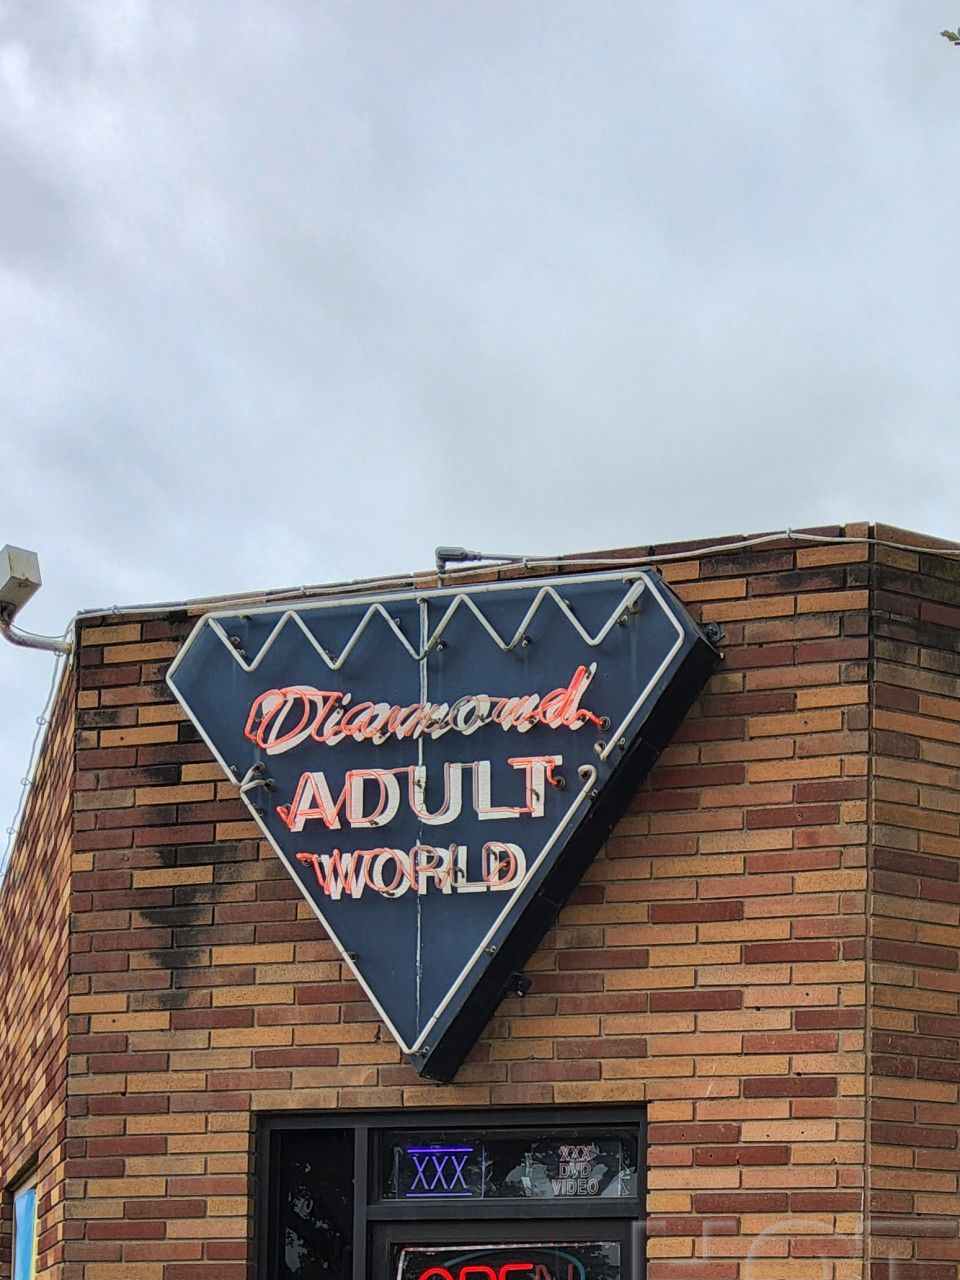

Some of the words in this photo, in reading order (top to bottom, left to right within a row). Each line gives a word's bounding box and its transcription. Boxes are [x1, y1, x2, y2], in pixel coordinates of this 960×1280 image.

[245, 662, 604, 754] Diamond
[277, 755, 564, 832] ADULT
[296, 841, 527, 900] WORLD
[559, 1162, 591, 1178] DVD
[560, 1146, 591, 1161] XXX
[411, 1155, 471, 1190] XXX
[552, 1178, 599, 1195] VIDEO
